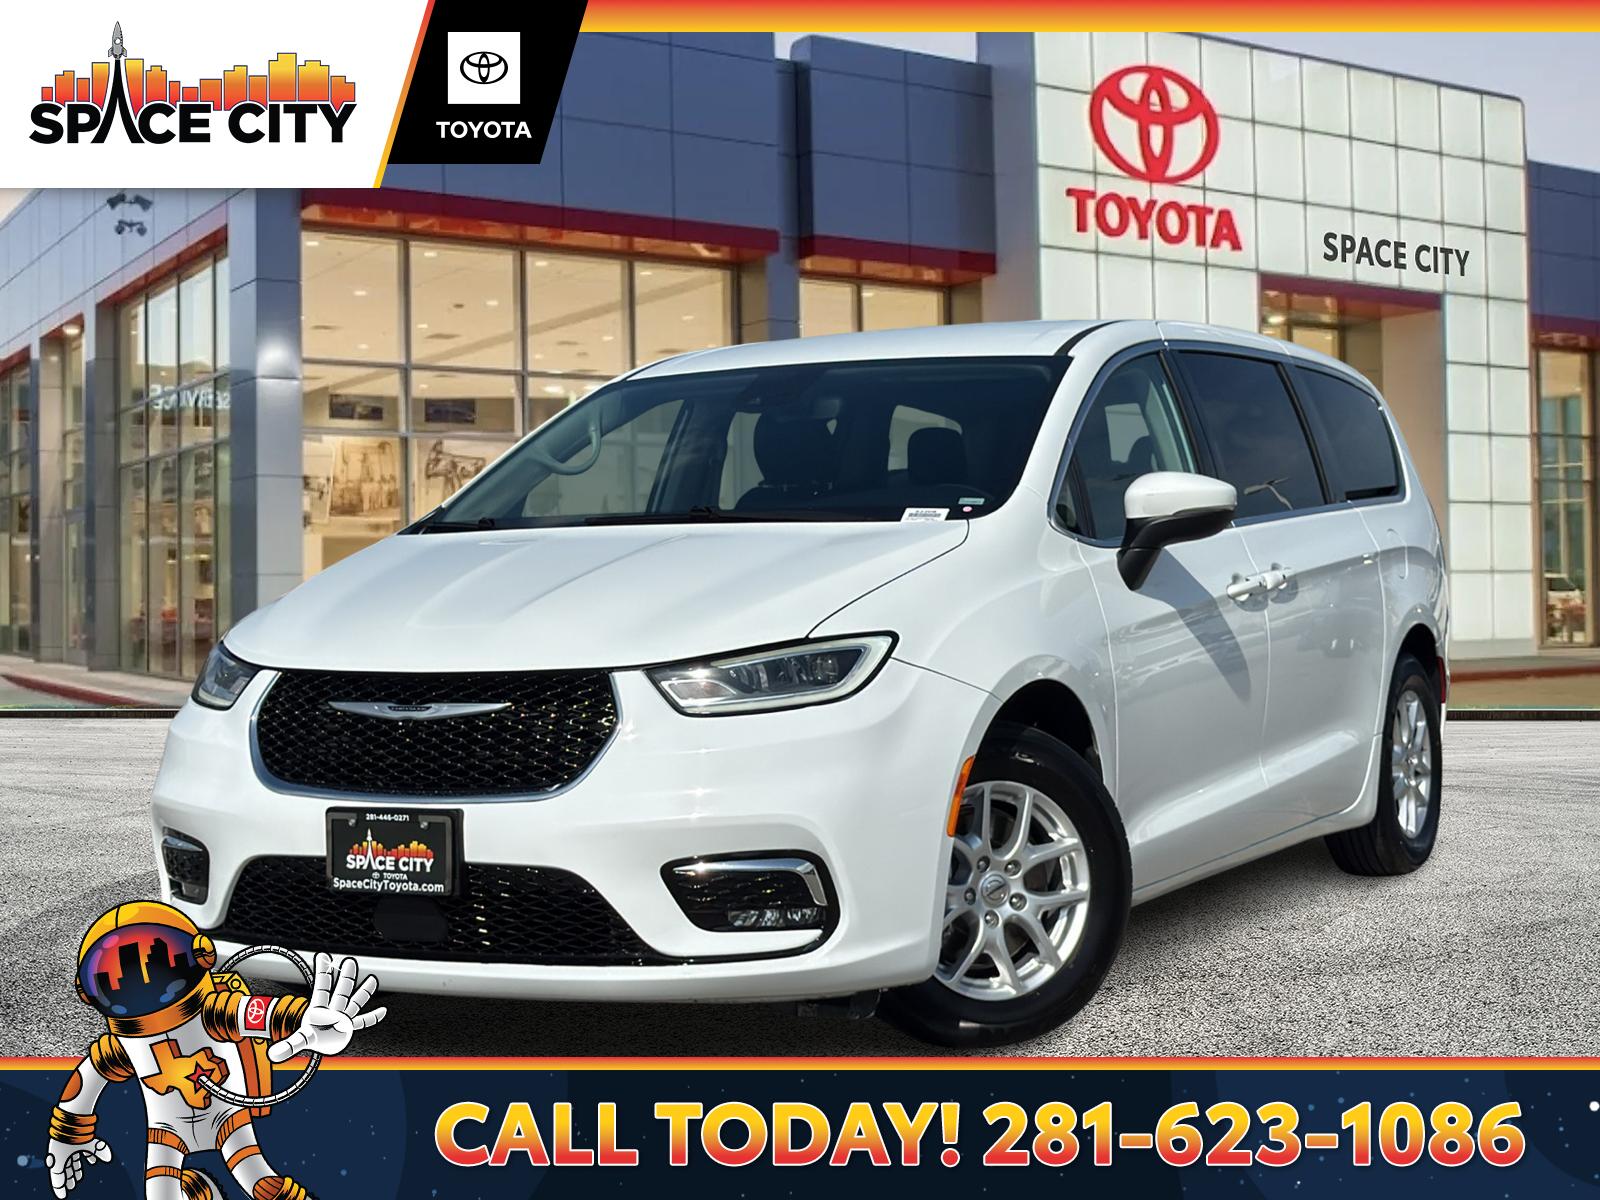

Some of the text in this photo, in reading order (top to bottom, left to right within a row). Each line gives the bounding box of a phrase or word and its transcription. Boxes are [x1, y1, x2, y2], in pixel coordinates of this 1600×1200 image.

[1066, 187, 1242, 251] TOYOTA
[1323, 231, 1470, 277] SPACE CITY
[346, 849, 434, 872] SPACE CITY
[333, 877, 444, 892] SpaceCityToyota.com
